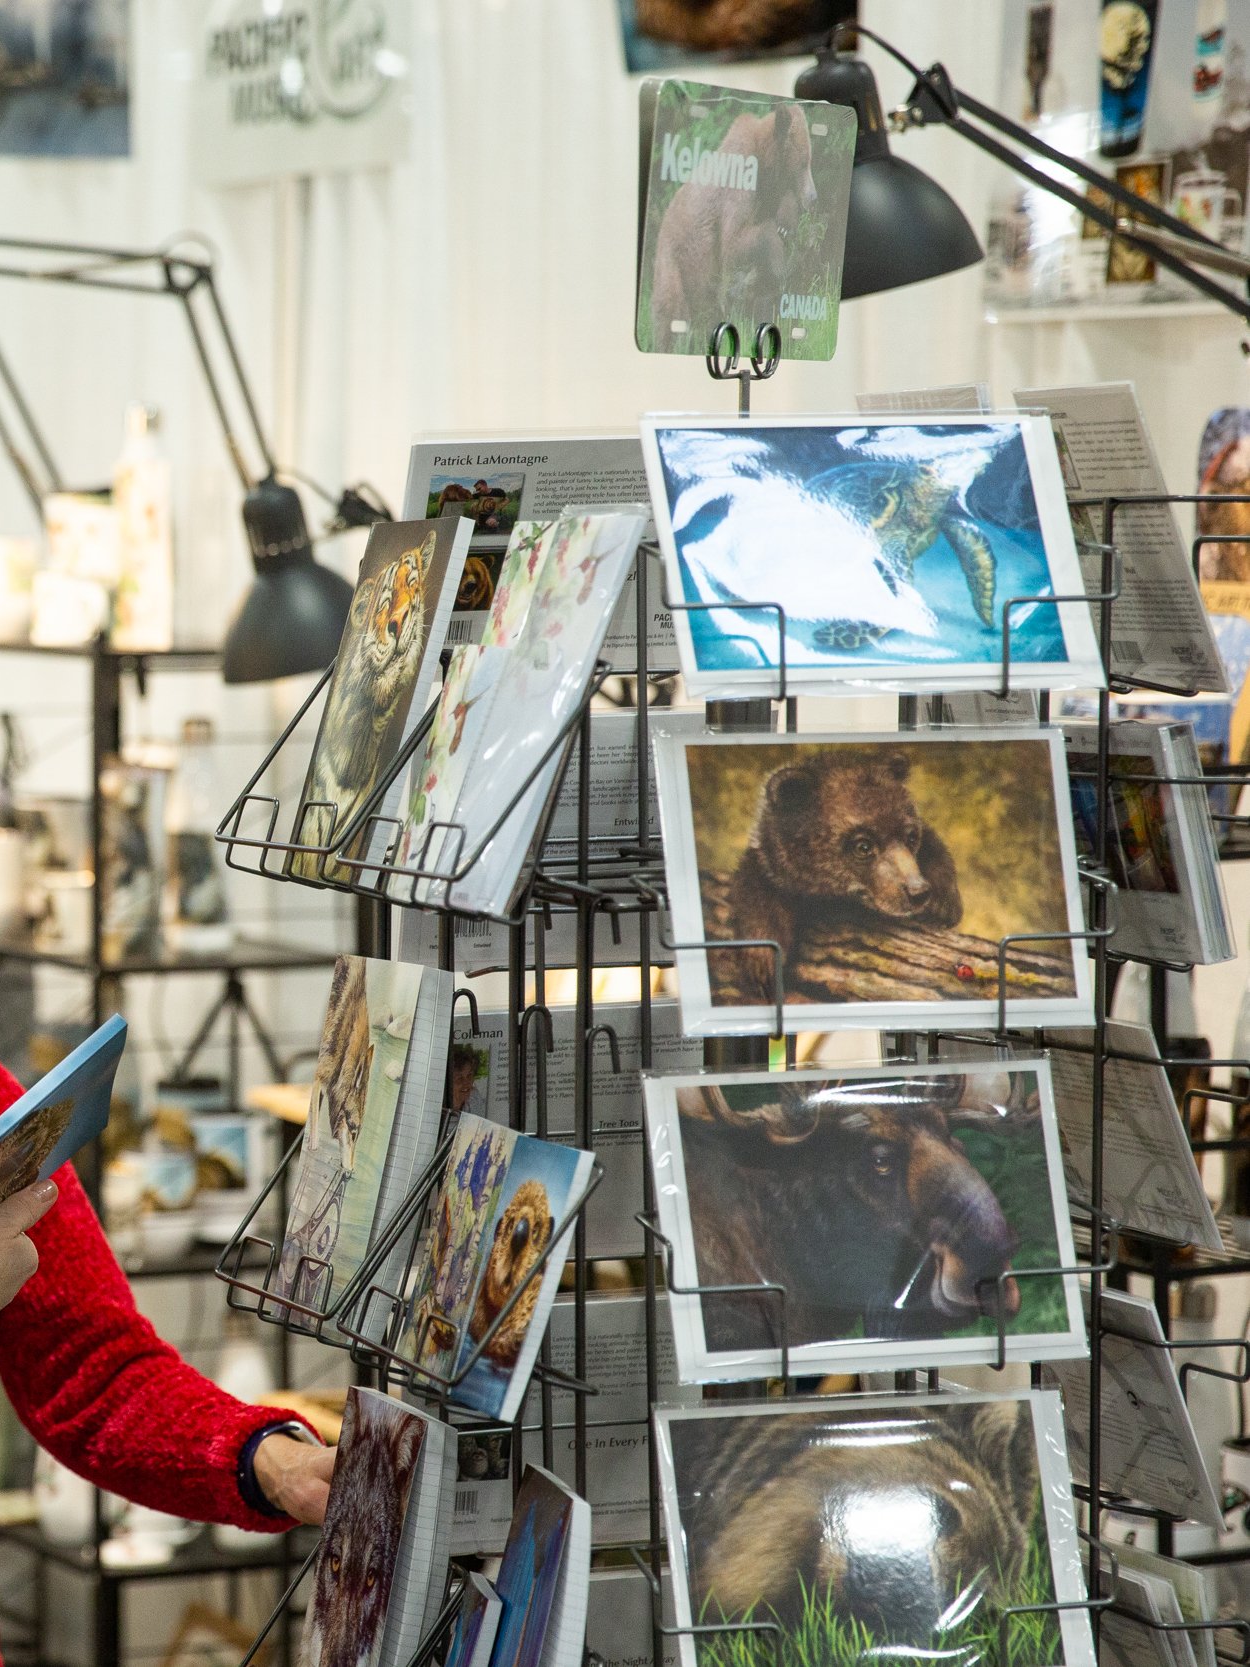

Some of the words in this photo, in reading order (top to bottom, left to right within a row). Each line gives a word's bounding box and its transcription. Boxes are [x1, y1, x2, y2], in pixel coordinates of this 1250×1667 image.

[661, 132, 759, 191] Kelowna
[780, 293, 828, 321] CANADA
[433, 455, 473, 466] Patrick
[476, 454, 549, 467] LaMontagne
[614, 816, 654, 827] Entwid
[568, 1440, 592, 1450] Oe
[596, 1439, 606, 1448] In
[609, 1437, 638, 1450] Every
